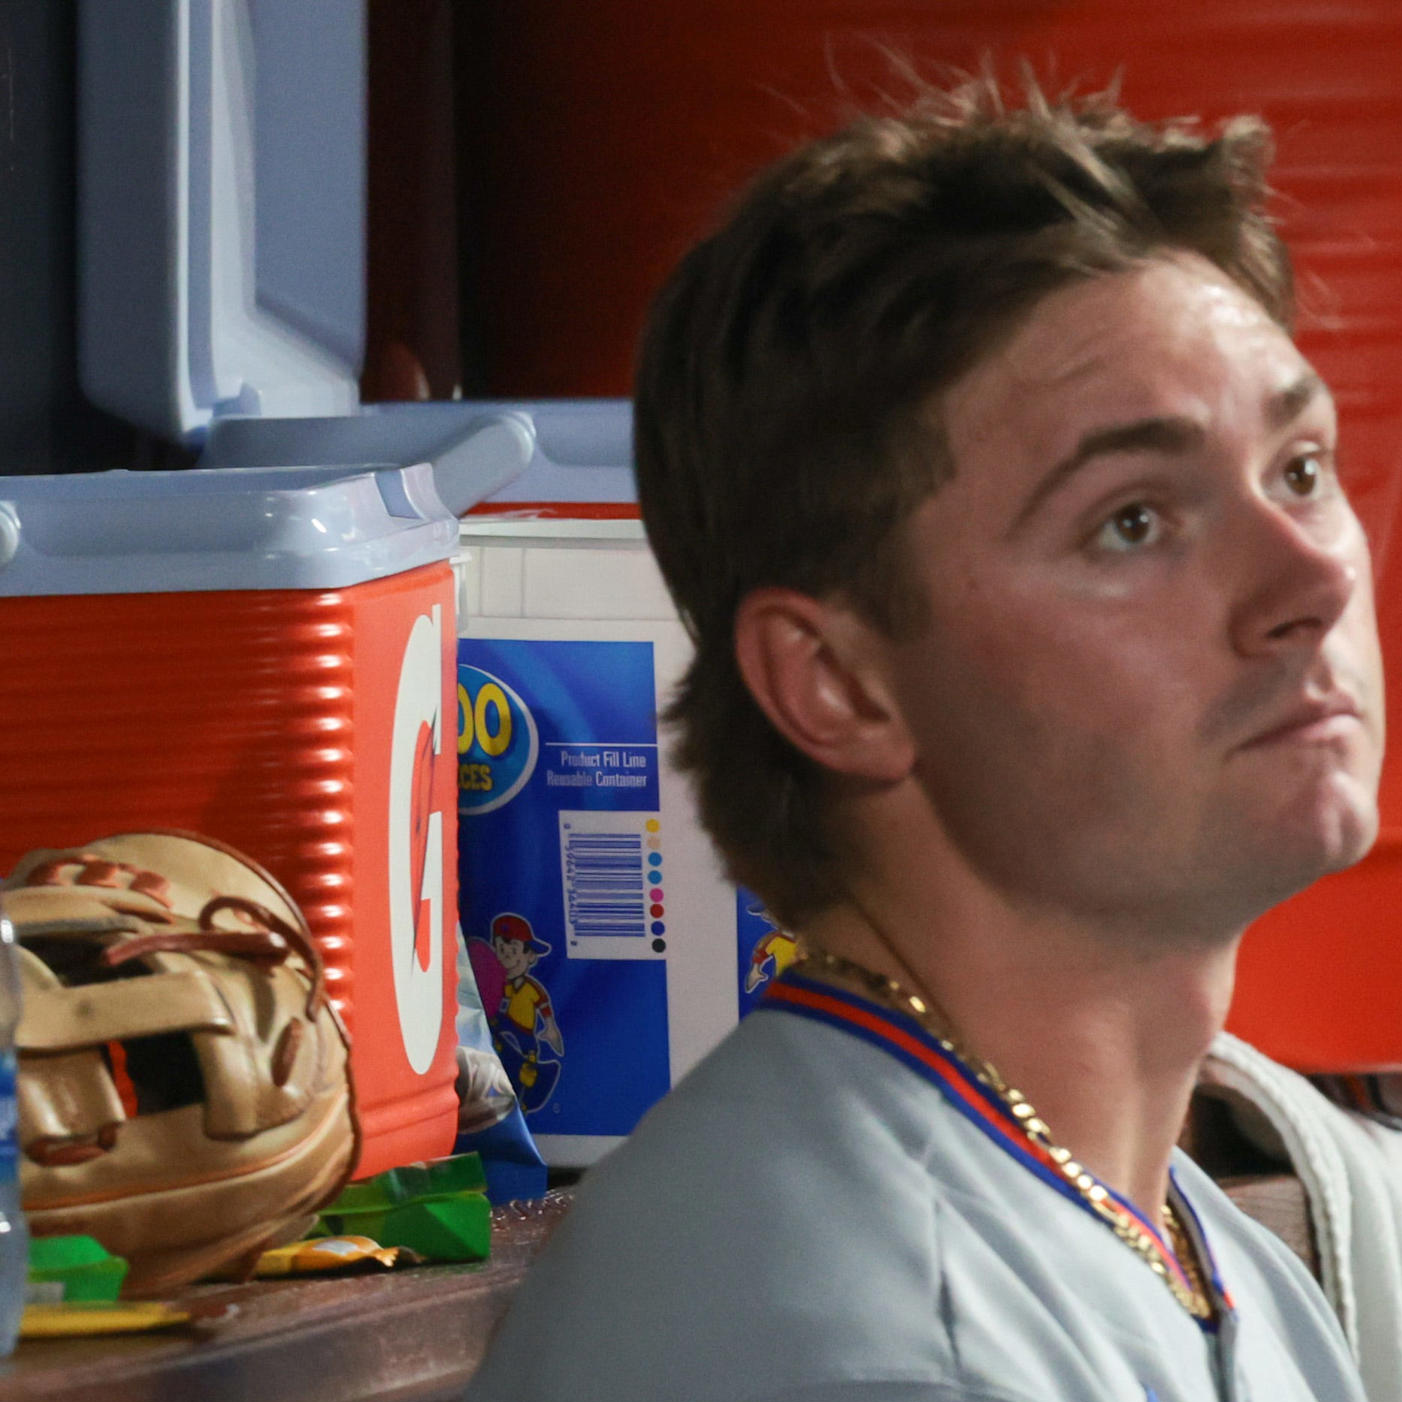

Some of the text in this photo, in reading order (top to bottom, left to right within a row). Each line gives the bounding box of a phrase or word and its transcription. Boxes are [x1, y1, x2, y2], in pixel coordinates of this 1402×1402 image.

[561, 750, 647, 768] Product Fill Line
[595, 771, 647, 787] Container
